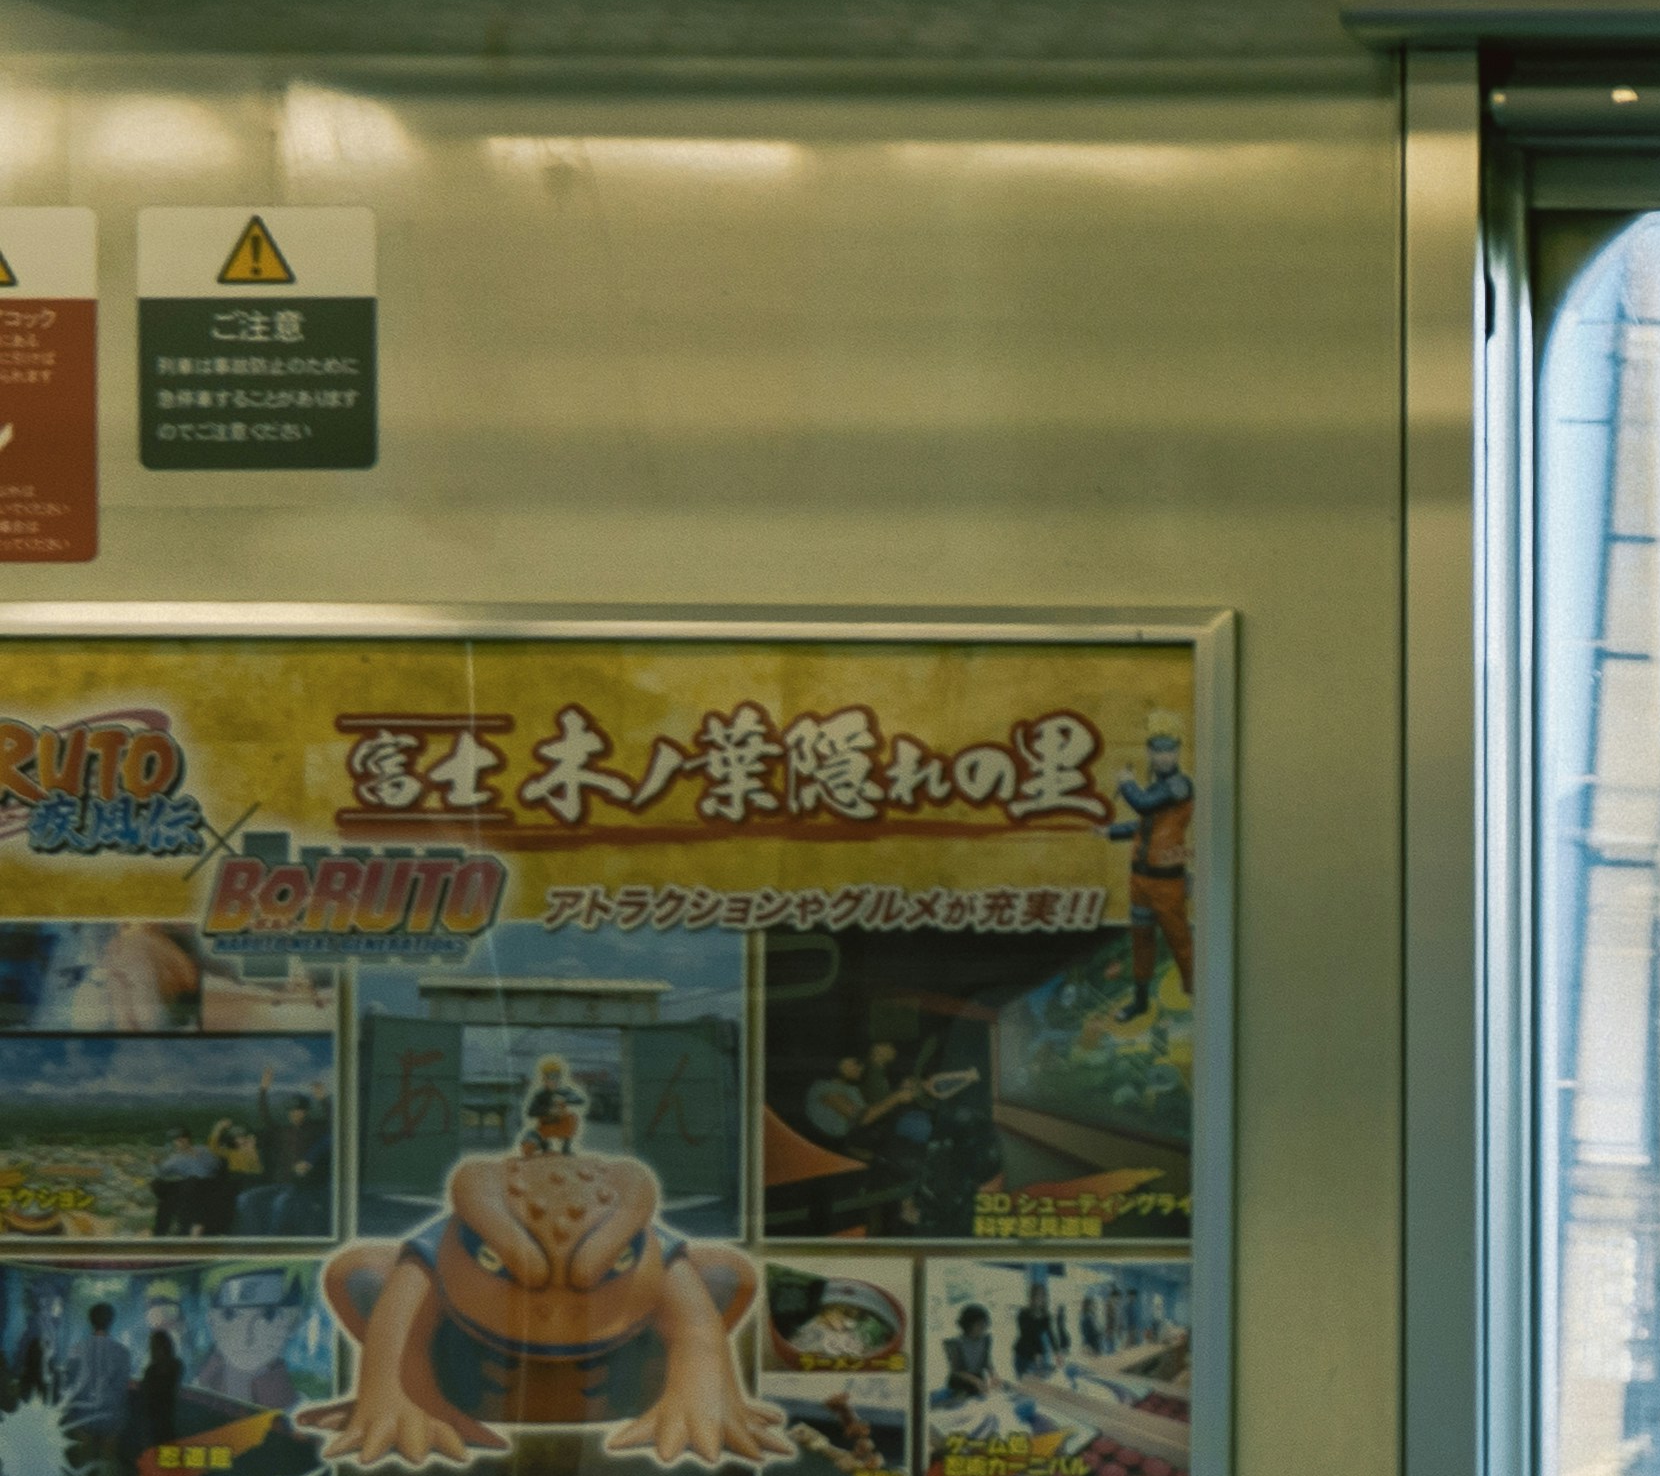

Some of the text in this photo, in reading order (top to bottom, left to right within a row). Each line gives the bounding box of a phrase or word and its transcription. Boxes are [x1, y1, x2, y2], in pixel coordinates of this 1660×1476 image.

[0, 307, 57, 330] コック
[211, 309, 306, 342] ご注意
[349, 705, 1108, 824] 富士 木ノ葉隠れの里
[29, 792, 205, 855] 疾風伝
[543, 887, 1107, 931] アトラクションやグルメが充実!!
